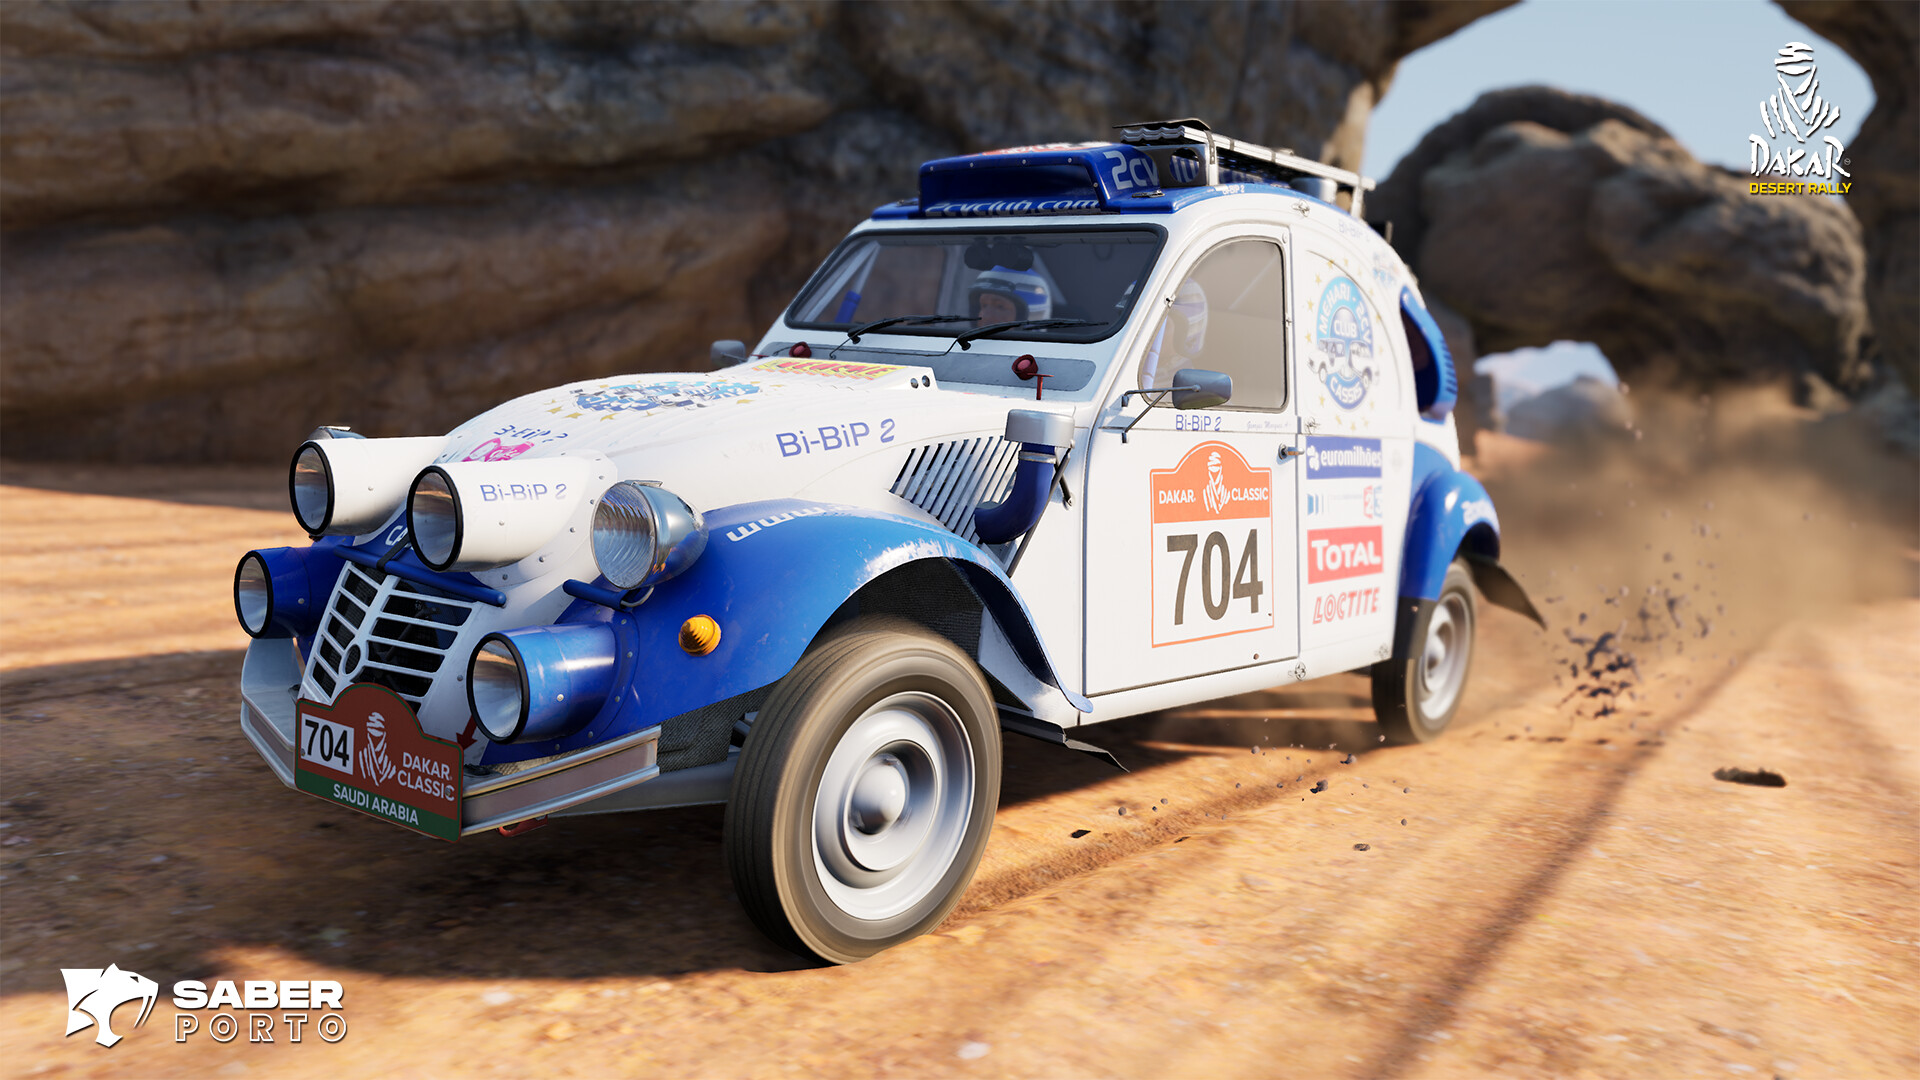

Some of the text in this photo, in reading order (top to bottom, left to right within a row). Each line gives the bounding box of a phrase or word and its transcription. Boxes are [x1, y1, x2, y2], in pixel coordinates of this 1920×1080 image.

[1333, 319, 1357, 338] CLUB
[776, 418, 896, 457] Bi-BiP 2
[1175, 414, 1222, 431] Bi-BiP 2
[480, 483, 567, 502] Bi-BiP 2
[1158, 487, 1268, 504] DAKAR CLASSIC
[1166, 528, 1263, 625] 704
[1312, 587, 1380, 625] LOCTITE
[305, 719, 350, 768] 704
[402, 751, 450, 780] DAKAR
[397, 770, 455, 802] CLASSIC
[333, 783, 419, 826] SAUDI ARABIA
